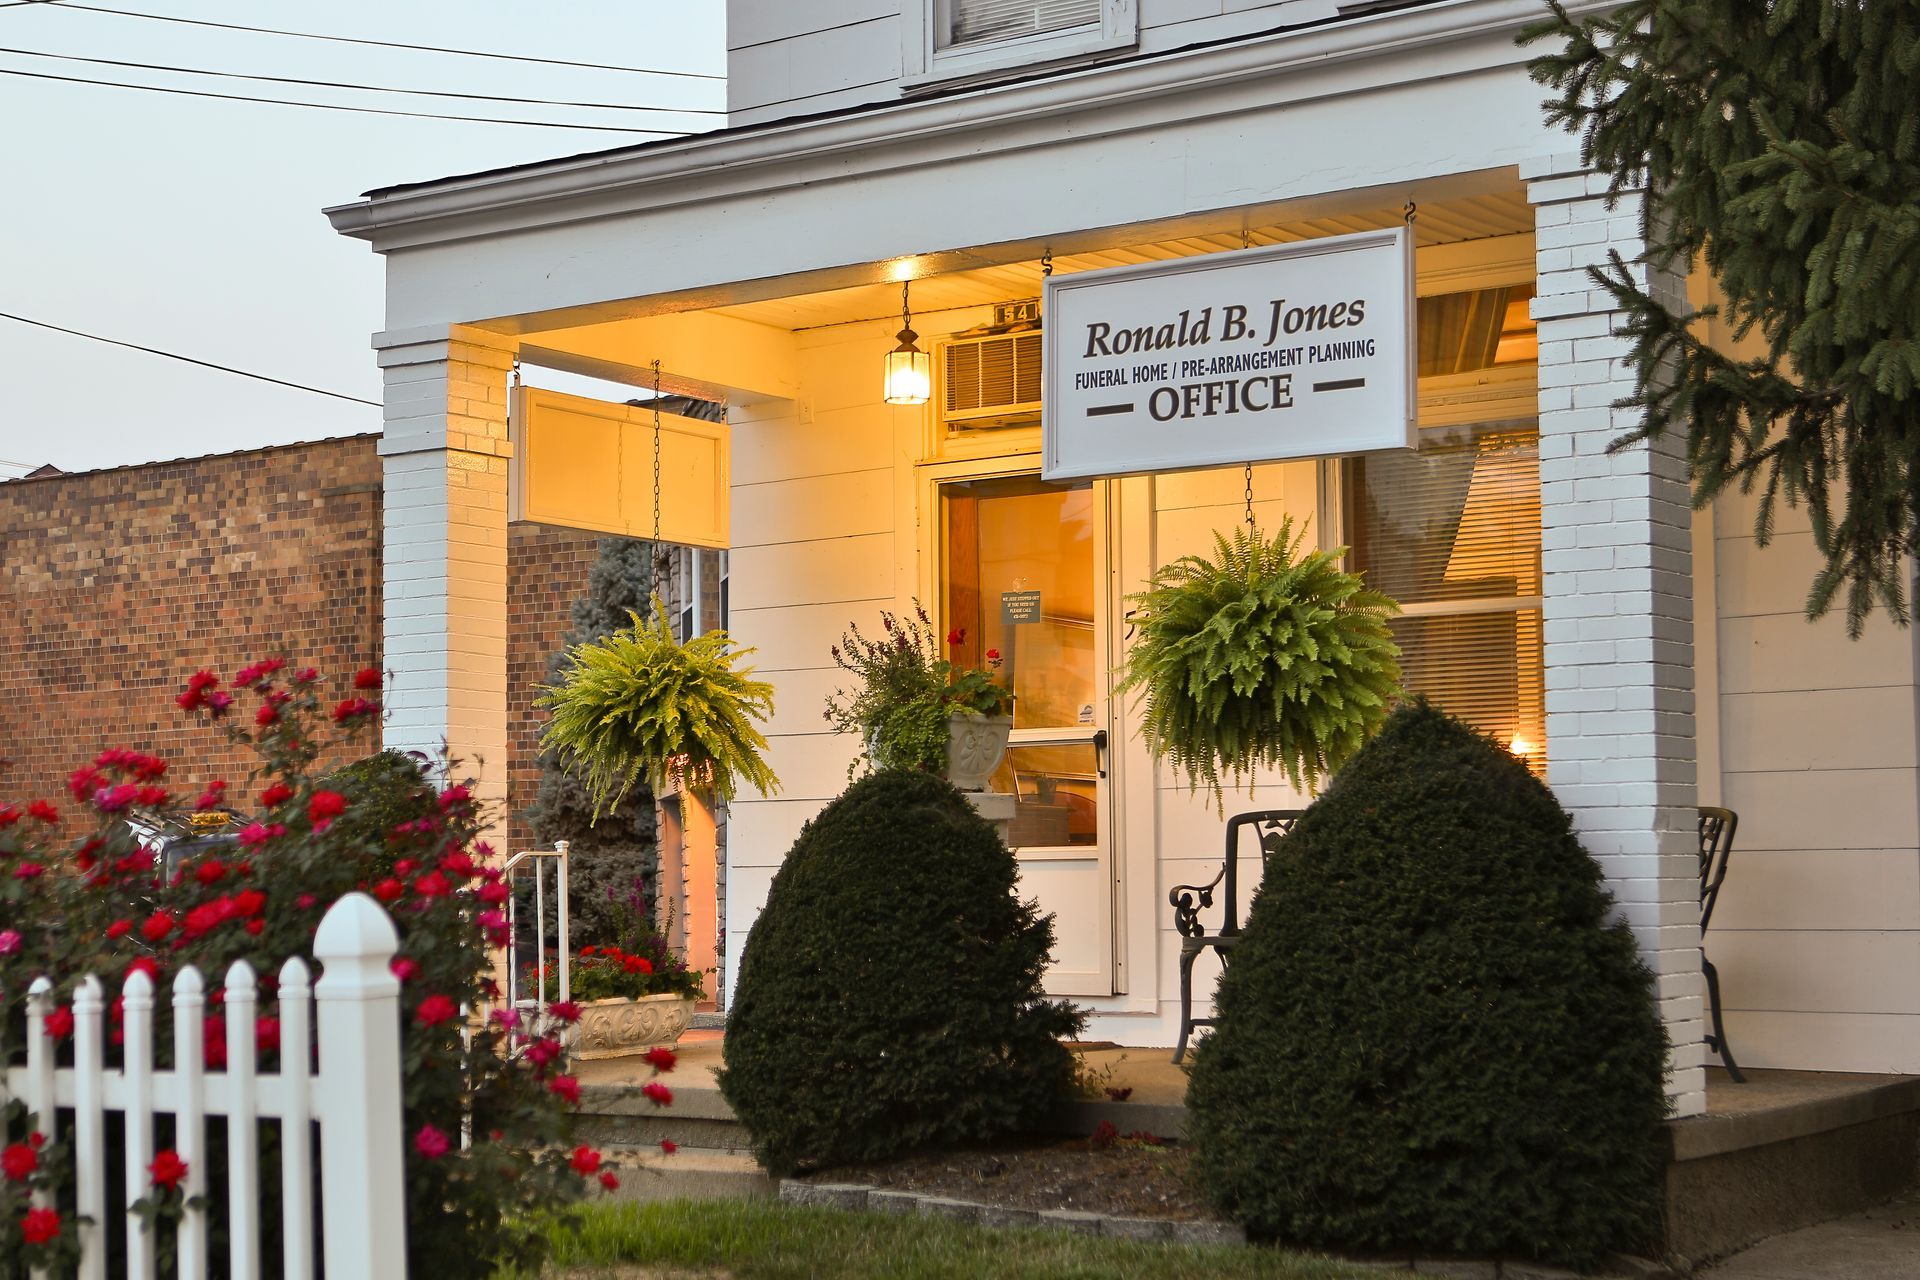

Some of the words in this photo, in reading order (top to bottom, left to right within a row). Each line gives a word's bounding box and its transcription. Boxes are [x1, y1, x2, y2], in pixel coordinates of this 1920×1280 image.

[1083, 307, 1213, 359] Ronald
[1220, 304, 1256, 342] B.
[1263, 299, 1366, 347] Jones
[1075, 366, 1128, 391] FUNERAL
[1132, 362, 1168, 385] HOME
[1172, 362, 1177, 380] /
[1181, 346, 1304, 379] PRE-ARRANGEMENT
[1308, 338, 1376, 364] PLANNING
[1148, 373, 1294, 422] OFFICE
